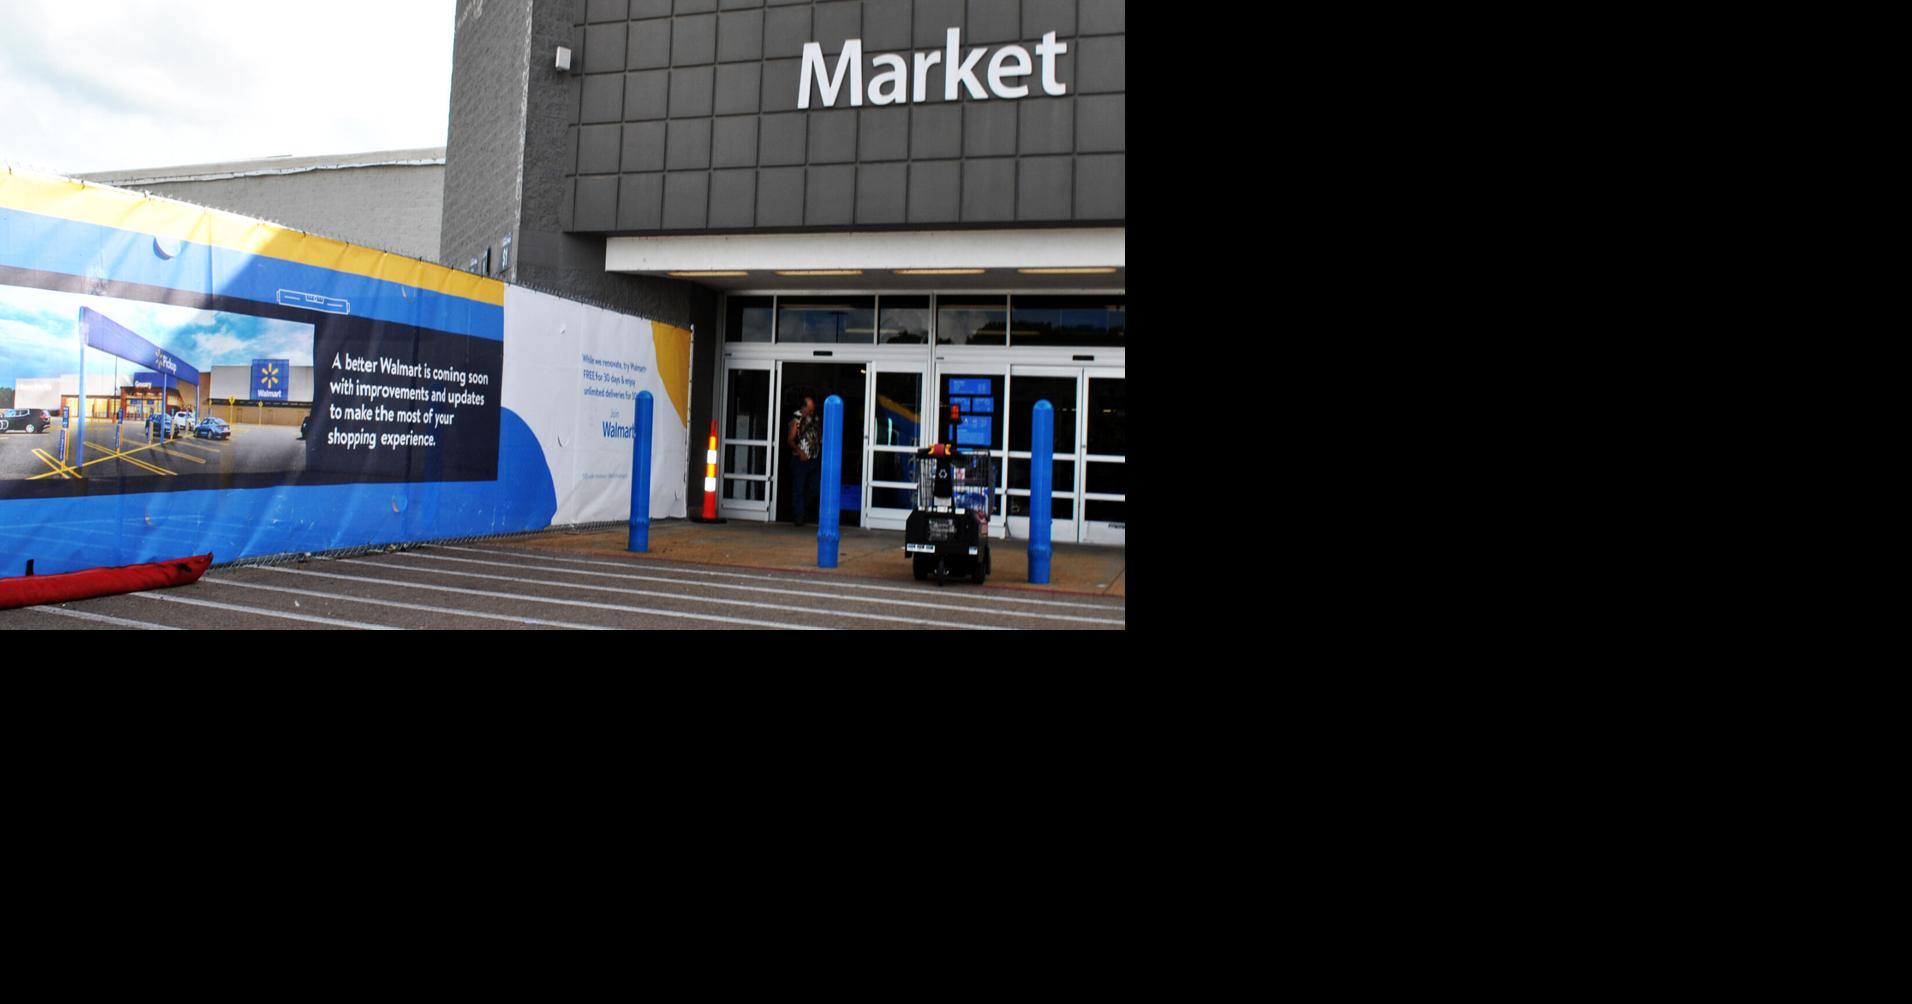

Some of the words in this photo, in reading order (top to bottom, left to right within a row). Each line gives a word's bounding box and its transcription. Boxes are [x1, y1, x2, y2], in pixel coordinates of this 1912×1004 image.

[797, 27, 1068, 110] Market
[332, 351, 342, 370] A
[345, 352, 378, 373] better
[380, 356, 422, 378] Walmart
[424, 362, 431, 379] is
[432, 366, 466, 387] coming
[468, 372, 489, 385] soon
[258, 389, 282, 398] Walmart
[330, 377, 354, 396] with
[356, 379, 429, 402] improvements
[431, 387, 446, 402] and
[448, 389, 485, 409] updates
[330, 403, 342, 420] to
[344, 403, 373, 421] make
[375, 405, 394, 422] the
[397, 408, 421, 423] most
[423, 408, 434, 424] of
[434, 413, 455, 429] your
[328, 427, 377, 450] shopping
[381, 430, 436, 450] experience.
